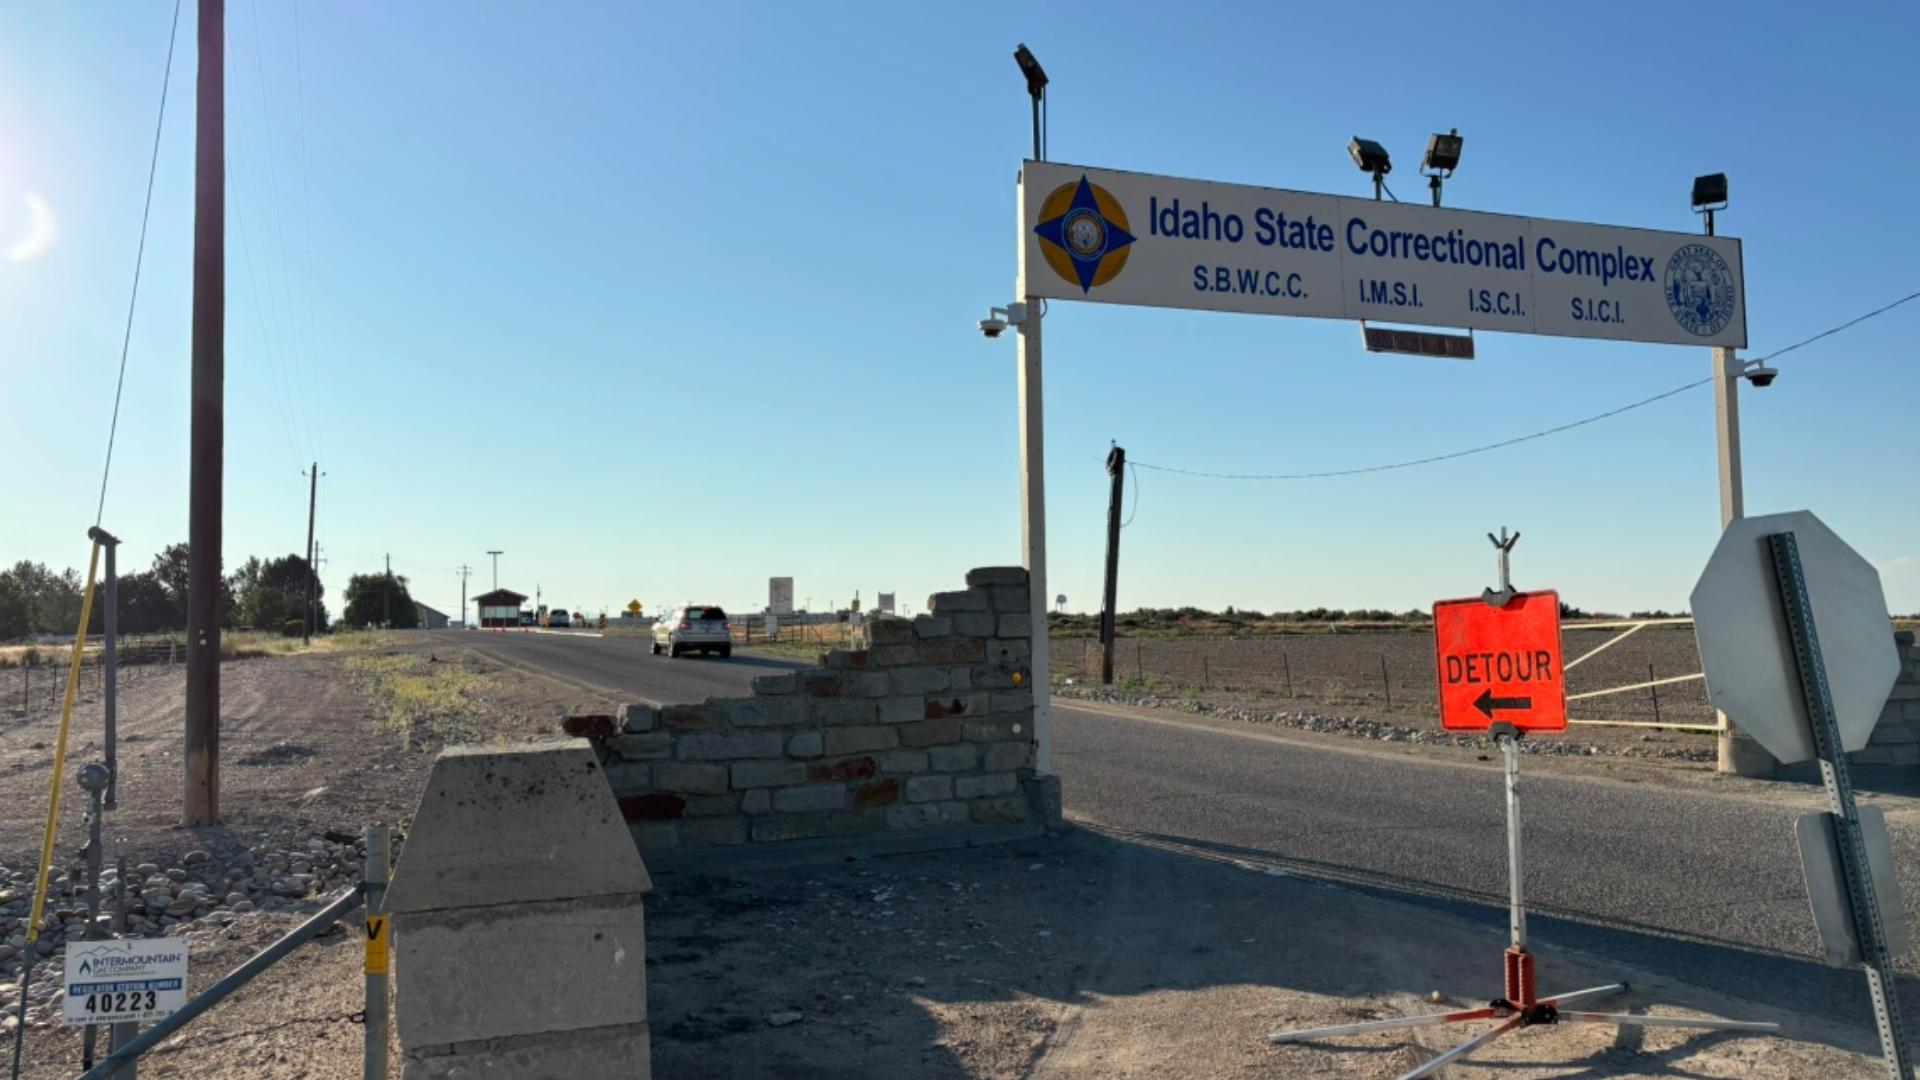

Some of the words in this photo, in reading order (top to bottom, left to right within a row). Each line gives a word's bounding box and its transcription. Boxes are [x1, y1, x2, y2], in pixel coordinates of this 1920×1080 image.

[1149, 196, 1244, 244] Idaho
[1254, 207, 1335, 252] State
[1346, 217, 1525, 271] Correctional
[1535, 236, 1657, 287] Complex
[1192, 264, 1309, 300] S.B.W.C.C.
[1359, 278, 1424, 308] I.M.S.I.
[1468, 288, 1526, 317] I.S.C.I.
[1570, 296, 1626, 324] S.I.C.I.
[1447, 650, 1552, 684] DETOUR
[93, 954, 180, 966] INTERMOUNTAIN
[86, 991, 156, 1013] 40223
